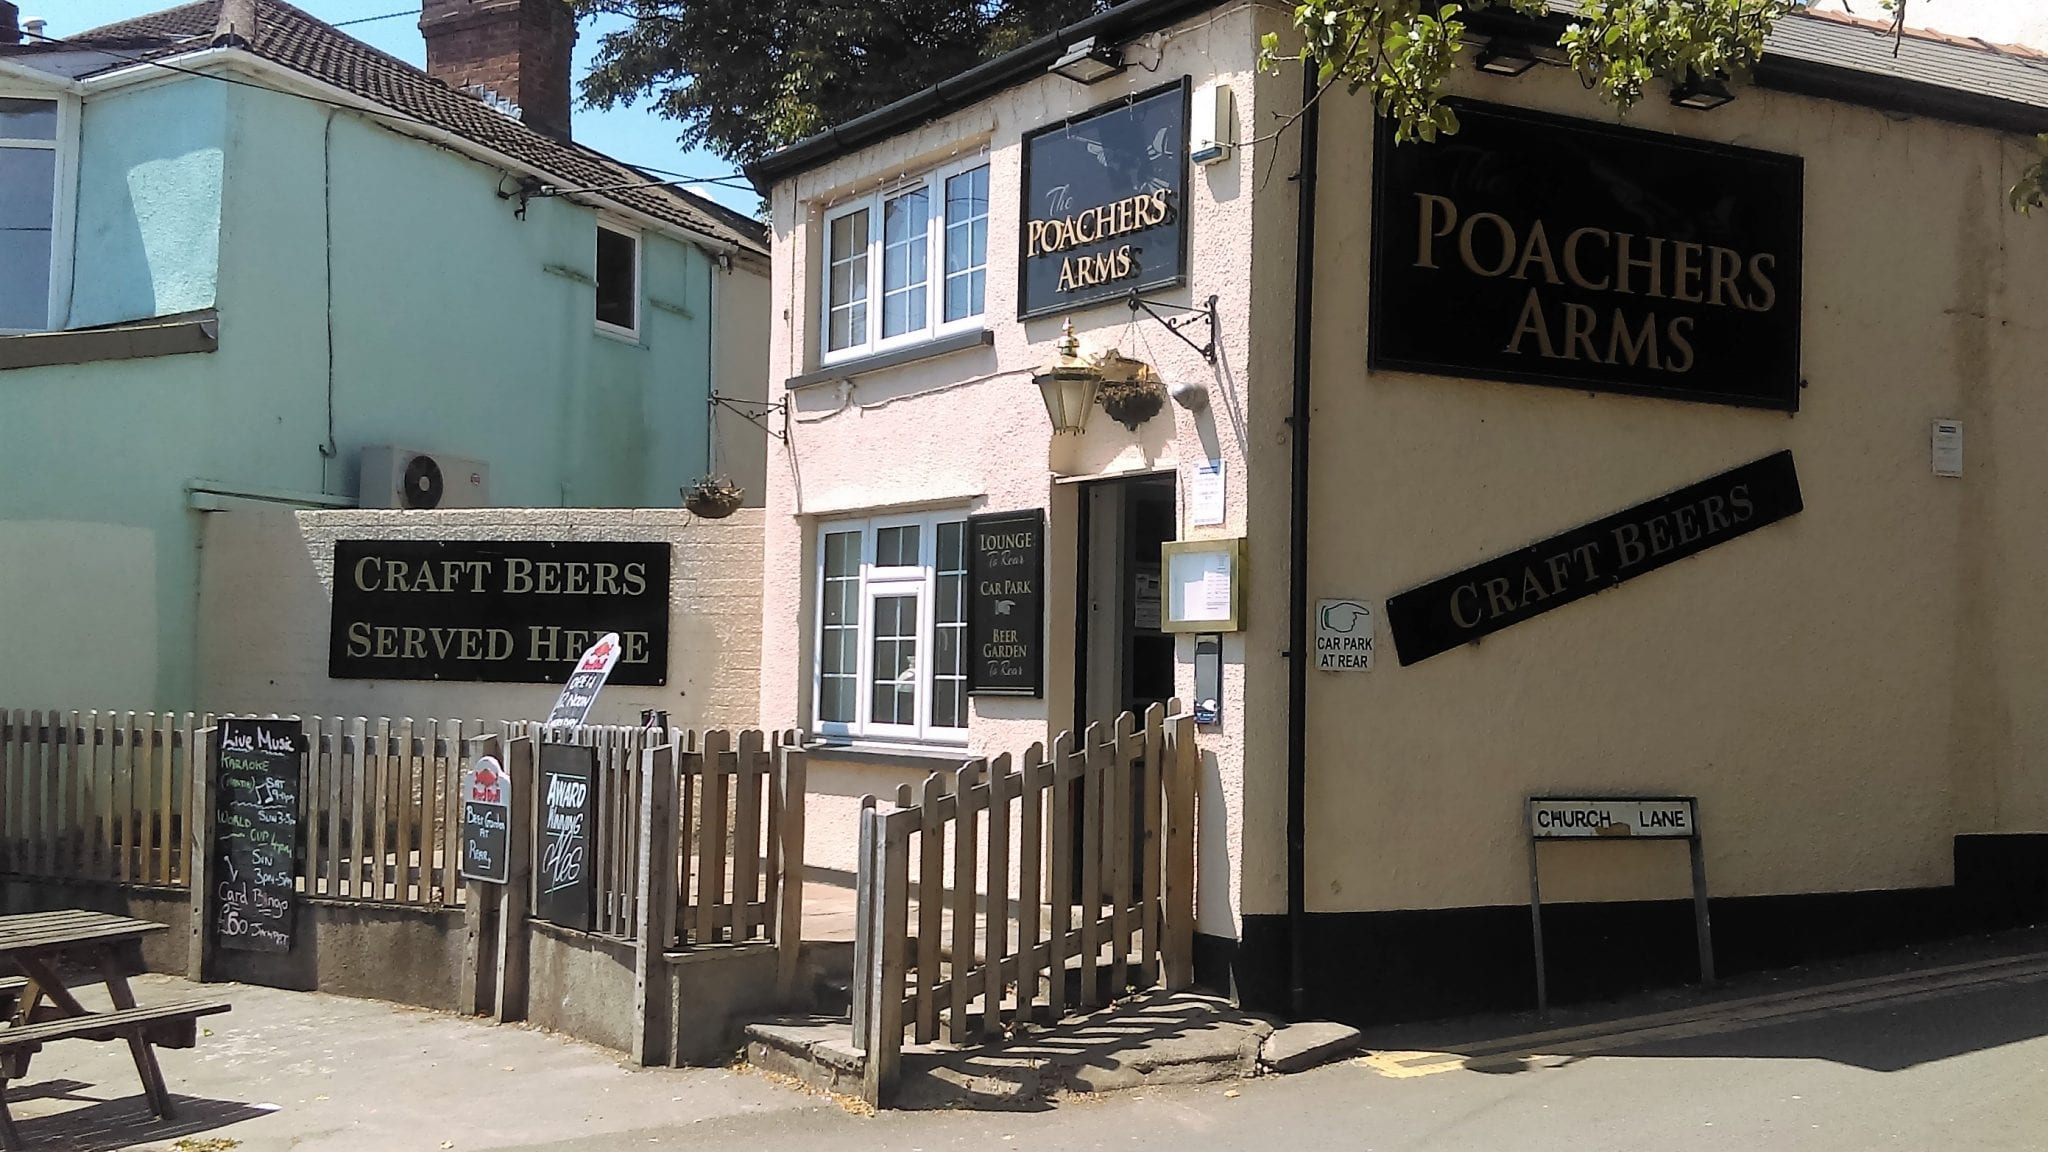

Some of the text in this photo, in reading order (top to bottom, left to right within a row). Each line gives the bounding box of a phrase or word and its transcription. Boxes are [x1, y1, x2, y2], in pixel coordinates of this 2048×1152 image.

[1046, 184, 1073, 216] The
[1027, 188, 1171, 258] POACHERS
[1413, 192, 1777, 312] POACHERS
[1056, 245, 1130, 293] ARMS
[1504, 286, 1695, 374] ARMS
[980, 532, 1032, 551] LOUNGE
[1001, 550, 1024, 566] Rear
[1450, 484, 1754, 629] CRAFT BEERS
[353, 556, 647, 596] CRAFT BEERS
[980, 580, 1032, 596] CAR PARK
[346, 621, 649, 664] SERVED HEE
[993, 628, 1018, 643] BEER
[1317, 637, 1372, 651] CAR PARK
[983, 643, 1027, 659] GARDEN
[1001, 659, 1023, 676] Rear
[1321, 654, 1368, 668] AT REAR
[222, 721, 295, 752] Live Music
[266, 777, 286, 789] SAT
[546, 773, 587, 809] AWARD
[217, 809, 252, 828] WORLD
[547, 807, 584, 835] WINNING
[1537, 810, 1686, 828] CHURCH LANE
[250, 828, 269, 842] CUP
[479, 828, 490, 839] AT
[219, 881, 248, 905] Card
